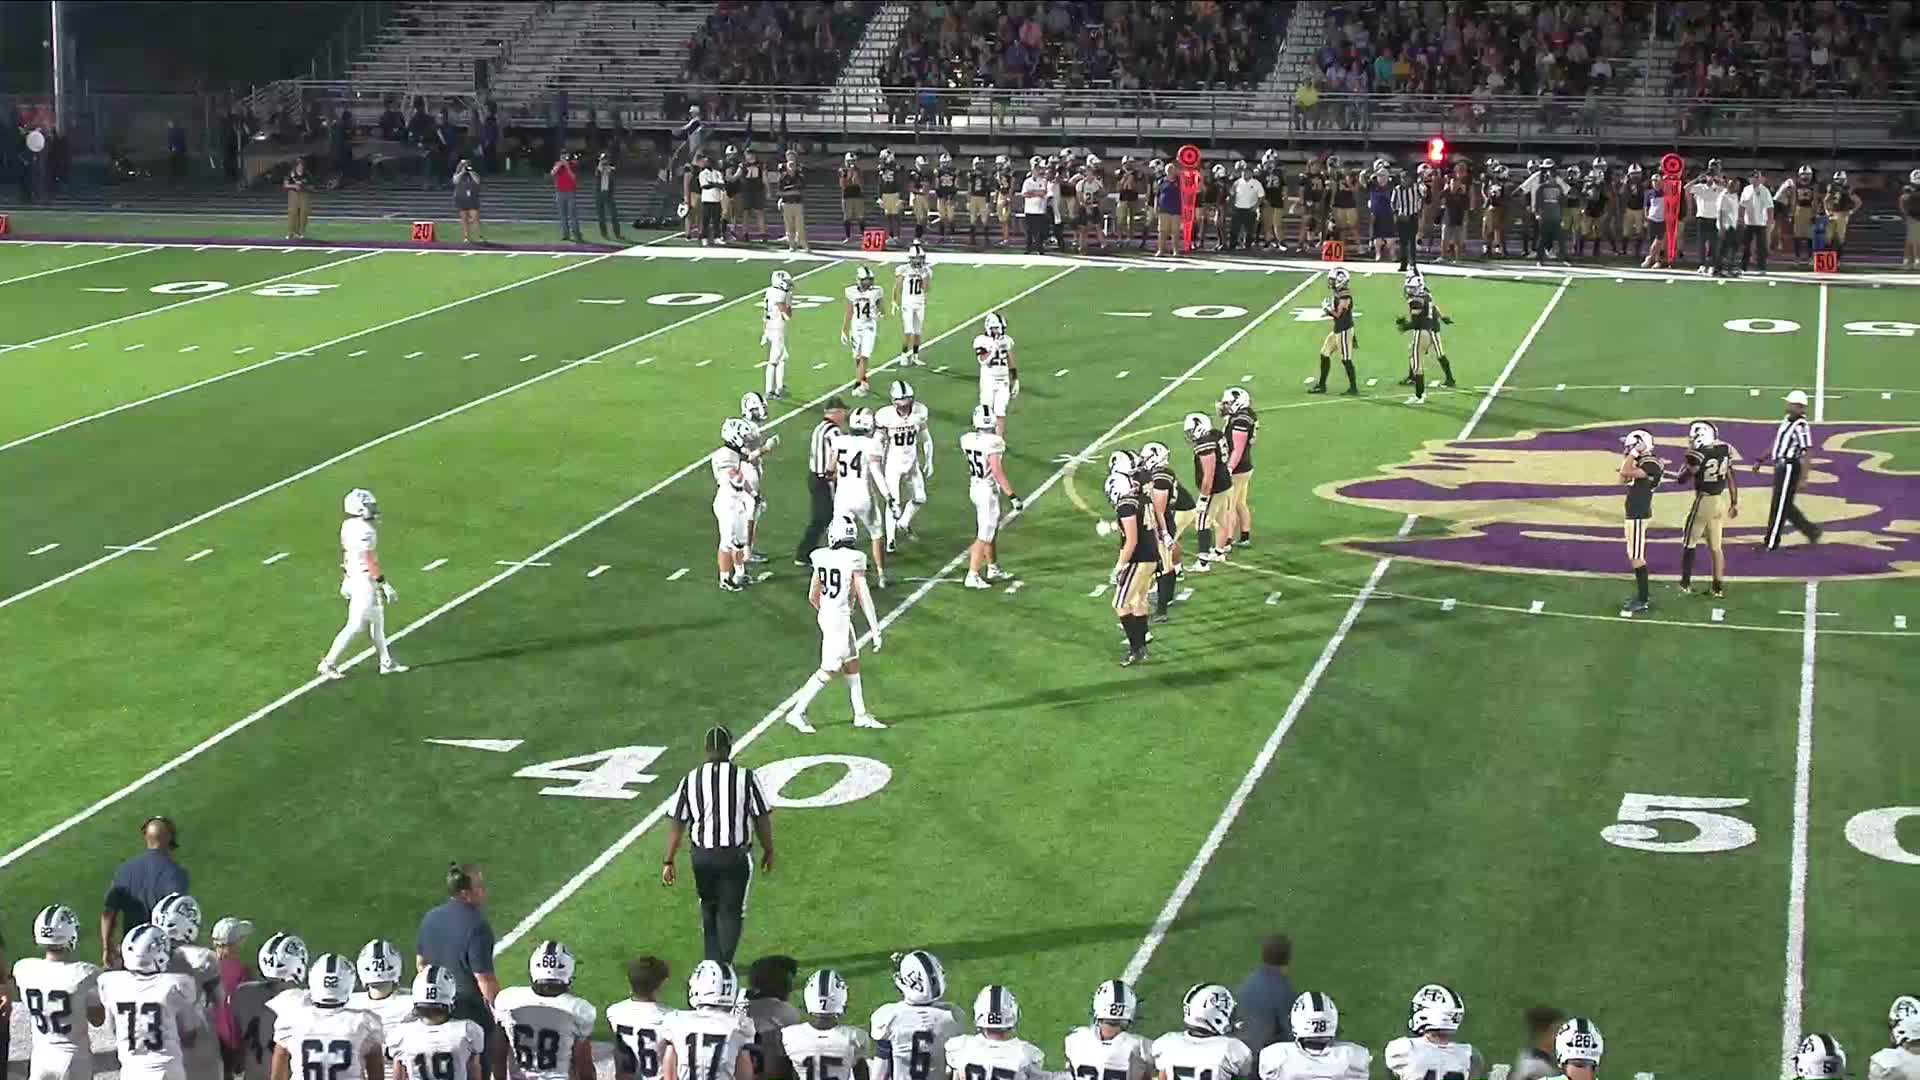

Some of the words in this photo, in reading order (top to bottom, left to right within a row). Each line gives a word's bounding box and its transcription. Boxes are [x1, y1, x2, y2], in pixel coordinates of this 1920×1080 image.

[414, 223, 430, 240] 20
[864, 232, 881, 248] 30
[1324, 244, 1342, 260] 40
[1815, 253, 1835, 271] 50
[909, 278, 922, 295] 10
[855, 302, 870, 318] 14
[837, 448, 863, 479] 54
[965, 449, 985, 479] 55
[1703, 456, 1728, 483] 24
[371, 959, 386, 973] 74
[721, 983, 733, 996] 17
[26, 988, 72, 1035] 82
[819, 1000, 827, 1011] 7
[117, 1002, 163, 1052] 73
[1311, 1020, 1327, 1033] 78
[513, 1023, 560, 1071] 68
[1575, 1034, 1591, 1049] 26
[301, 1039, 352, 1080] 62
[685, 1032, 727, 1080] 17
[910, 1030, 934, 1080] 6
